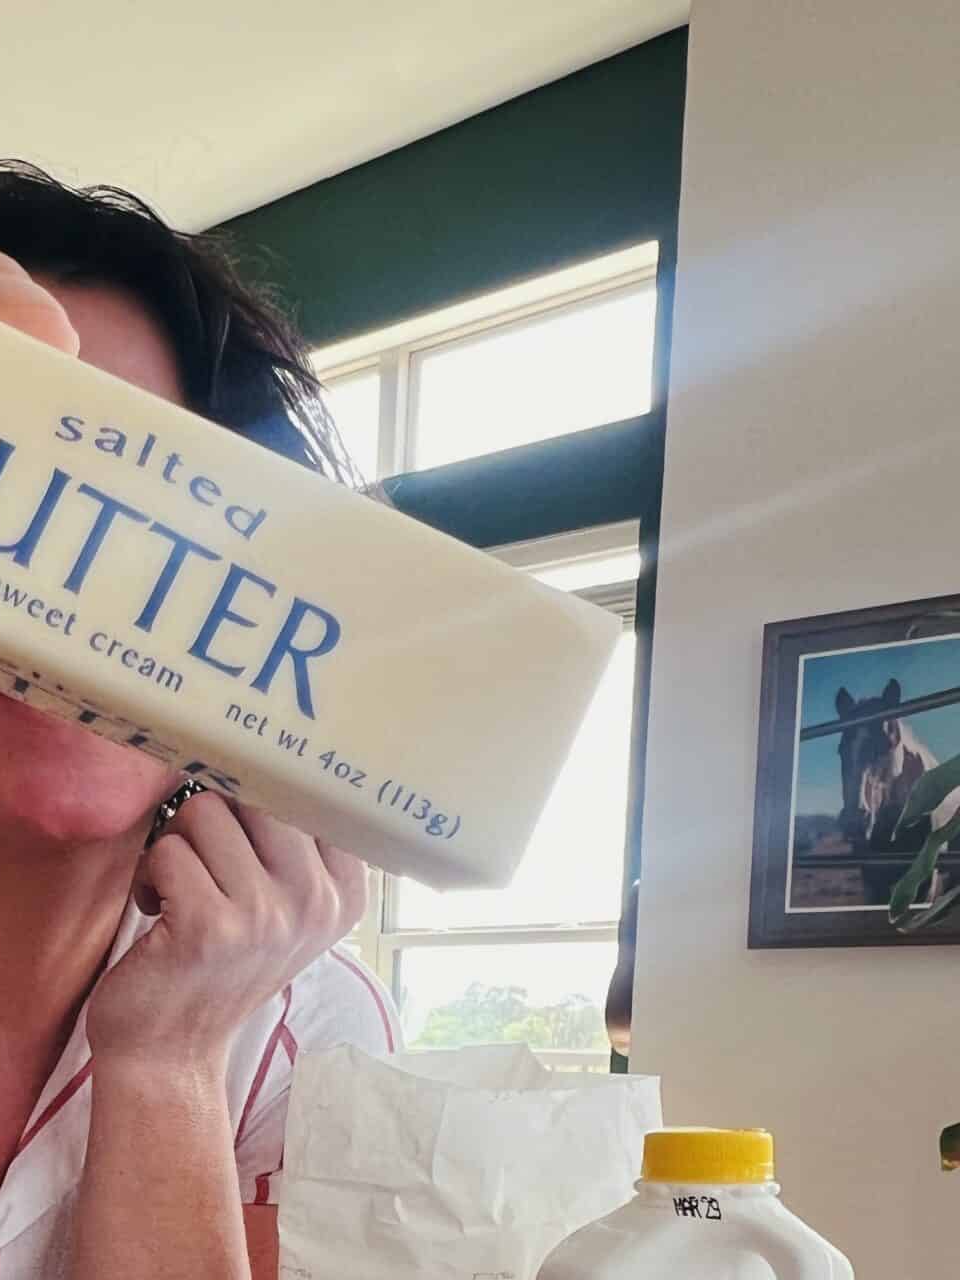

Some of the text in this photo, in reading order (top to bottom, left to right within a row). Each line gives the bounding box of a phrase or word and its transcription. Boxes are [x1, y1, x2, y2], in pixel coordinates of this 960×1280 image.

[55, 410, 269, 541] salted
[88, 628, 185, 694] cream
[225, 698, 463, 842] net wt 4oz (113g)
[673, 1196, 702, 1218] MAR
